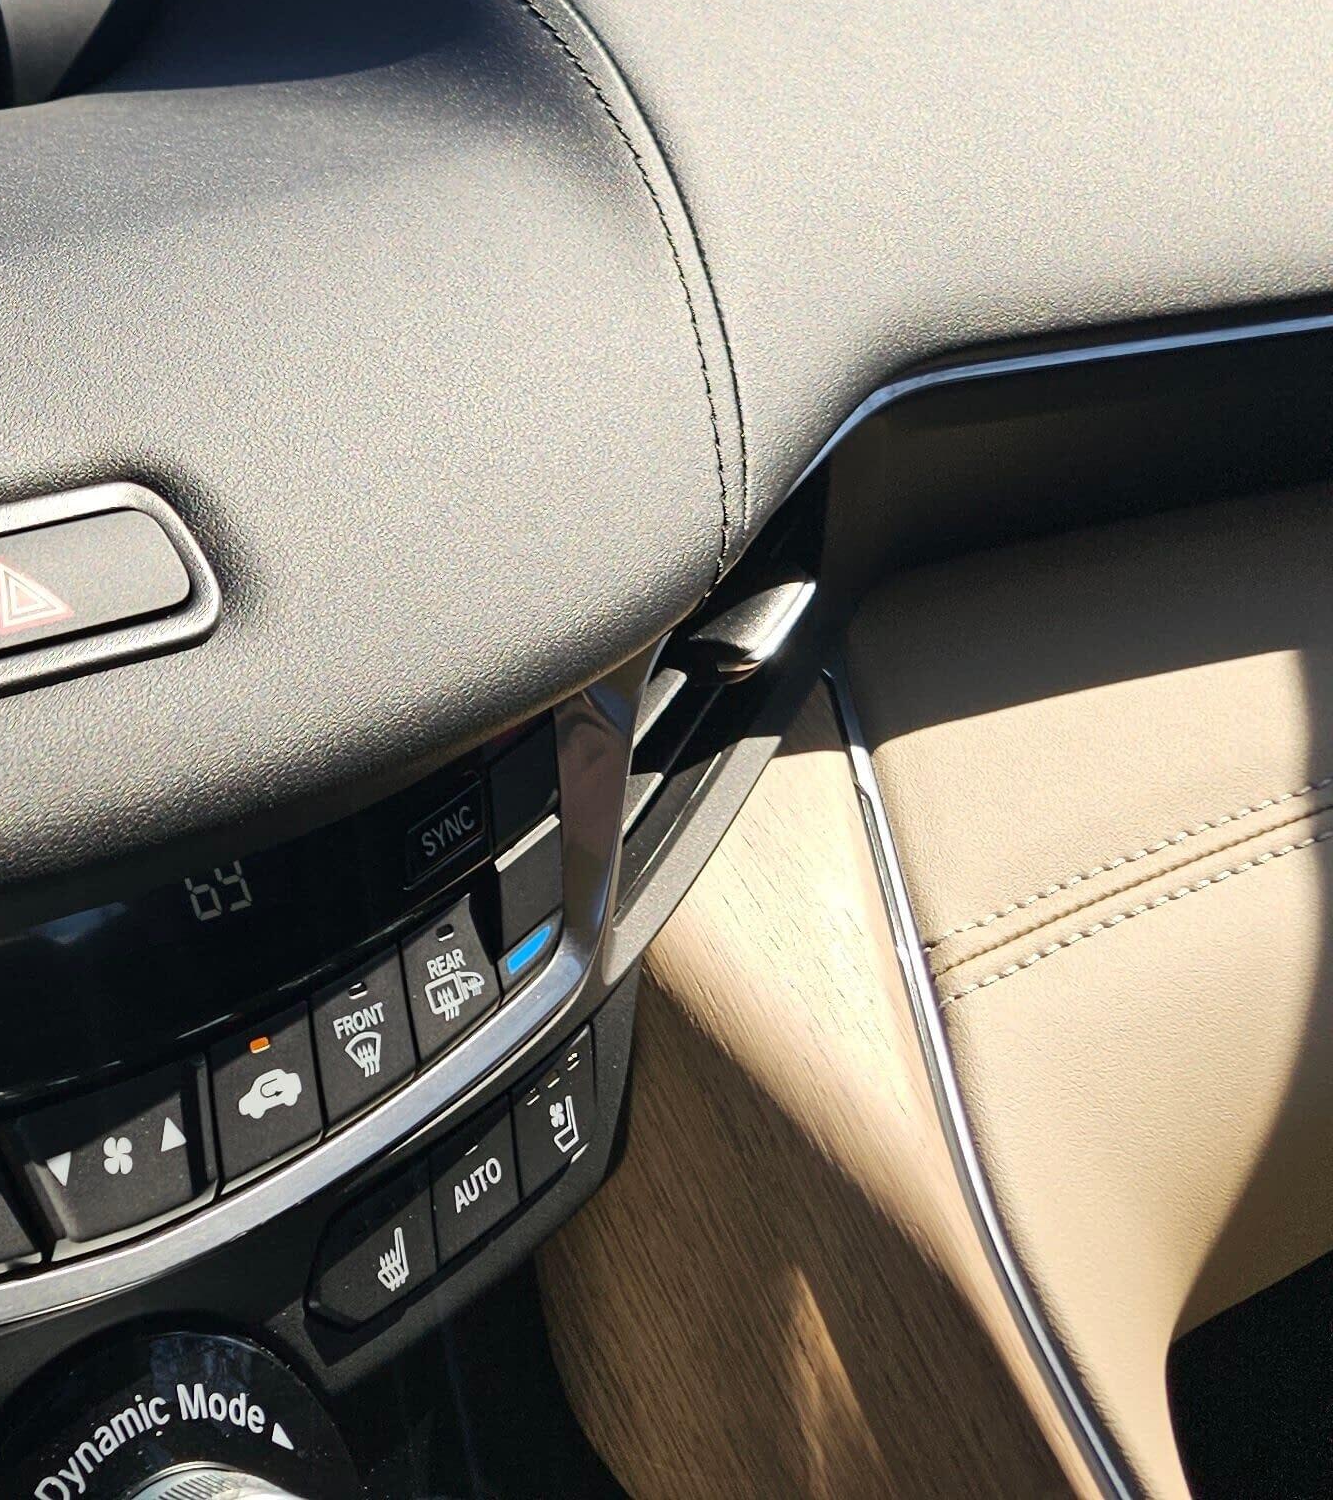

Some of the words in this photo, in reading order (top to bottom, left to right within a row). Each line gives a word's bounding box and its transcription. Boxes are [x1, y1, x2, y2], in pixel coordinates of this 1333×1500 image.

[420, 805, 475, 857] SYNC
[426, 948, 466, 980] REAR
[333, 1002, 385, 1040] FRONT
[453, 1157, 502, 1214] AUTO
[34, 1394, 170, 1500] Dynamic
[176, 1383, 266, 1434] Mode
